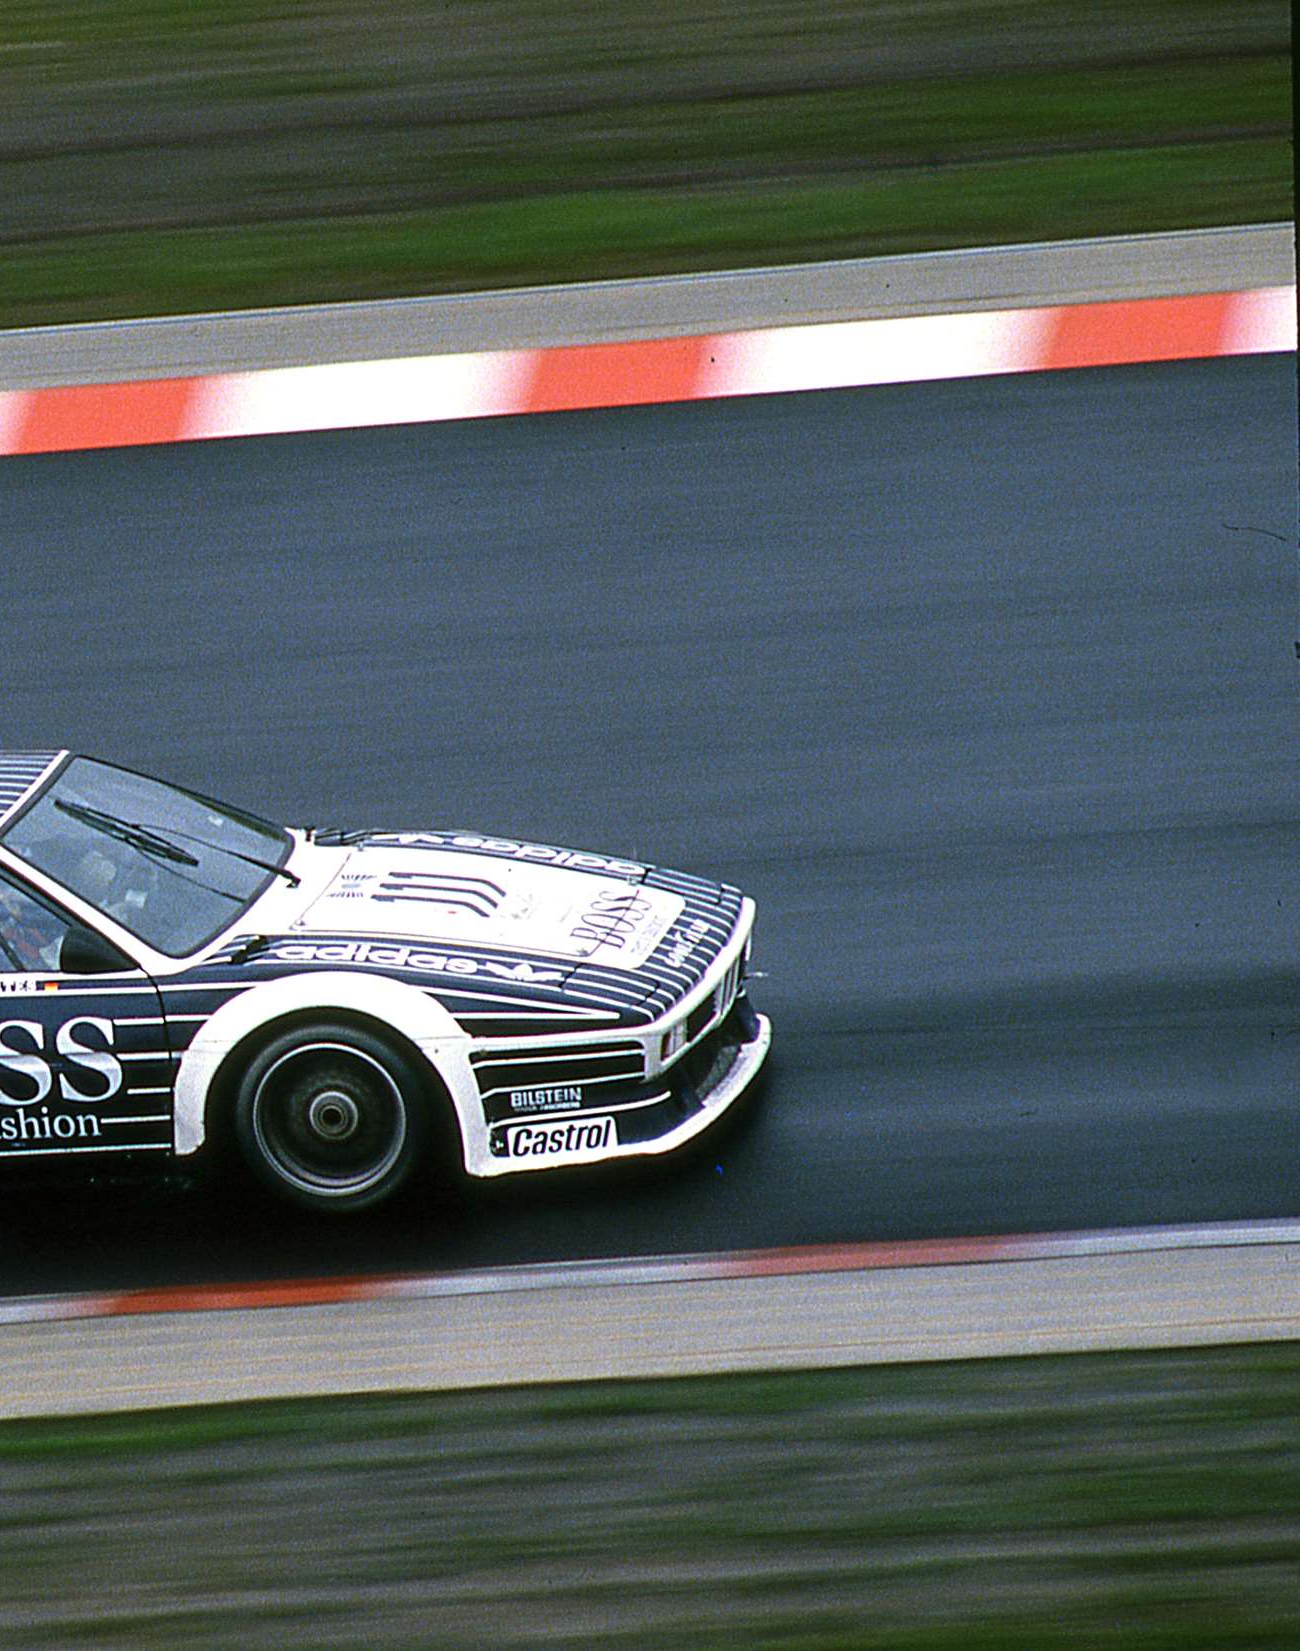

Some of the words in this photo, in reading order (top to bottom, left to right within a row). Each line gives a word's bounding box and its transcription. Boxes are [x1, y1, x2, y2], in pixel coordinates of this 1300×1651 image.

[570, 889, 652, 950] BOSS
[275, 943, 478, 975] adidas
[510, 1087, 582, 1108] BILSTEIN
[512, 1119, 612, 1157] Castrol
